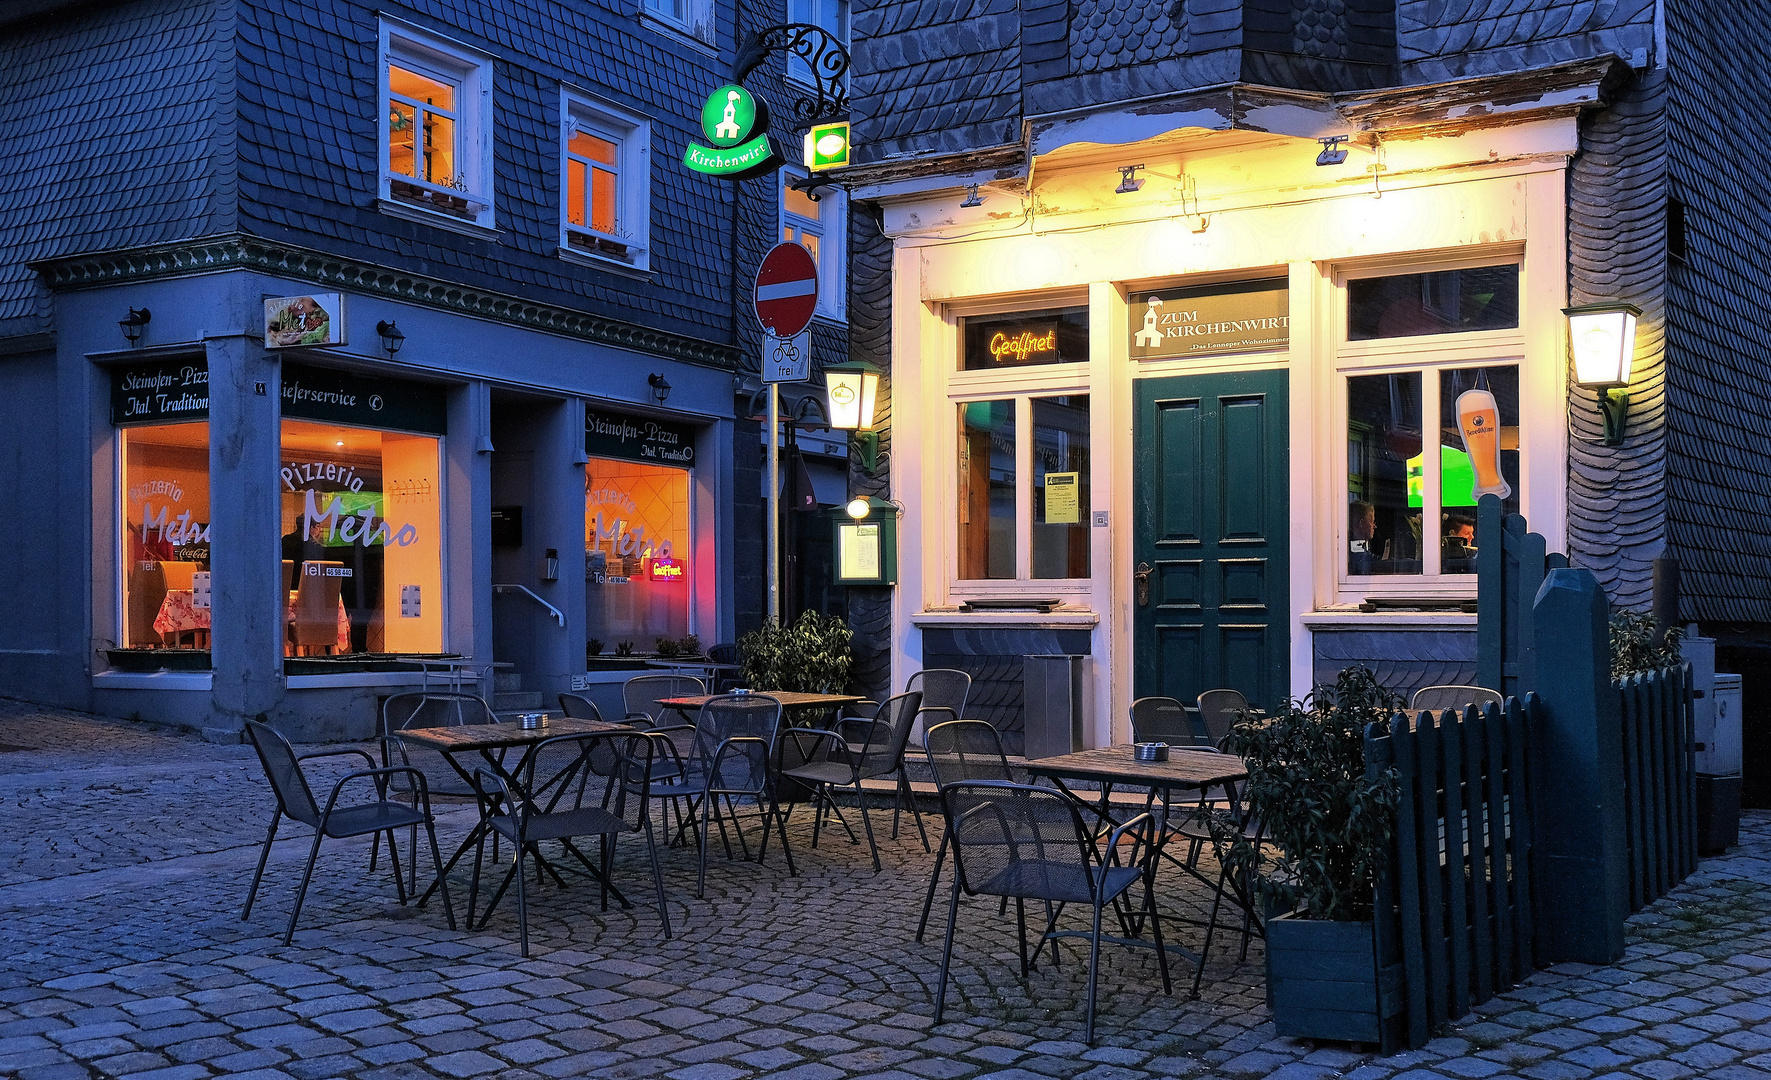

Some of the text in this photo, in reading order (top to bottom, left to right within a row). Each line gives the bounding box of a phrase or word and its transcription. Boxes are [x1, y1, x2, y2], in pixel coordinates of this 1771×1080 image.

[689, 143, 766, 168] Kirchenwirt
[279, 309, 323, 331] Metro
[1160, 310, 1198, 325] ZUM
[1166, 315, 1289, 338] KIRCHENWIRT
[990, 330, 1055, 361] Geöffnet
[121, 366, 208, 393] Steinofen-Pizz
[778, 365, 794, 376] frei
[156, 392, 209, 413] Tradition
[281, 381, 356, 406] ieferservice
[658, 446, 689, 461] Traditio
[281, 461, 364, 494] Pizzeria
[129, 479, 184, 505] Pizzeria
[303, 488, 419, 548] Metro
[594, 511, 674, 560] Metro
[140, 560, 156, 571] Tel.
[302, 561, 326, 577] Tel.
